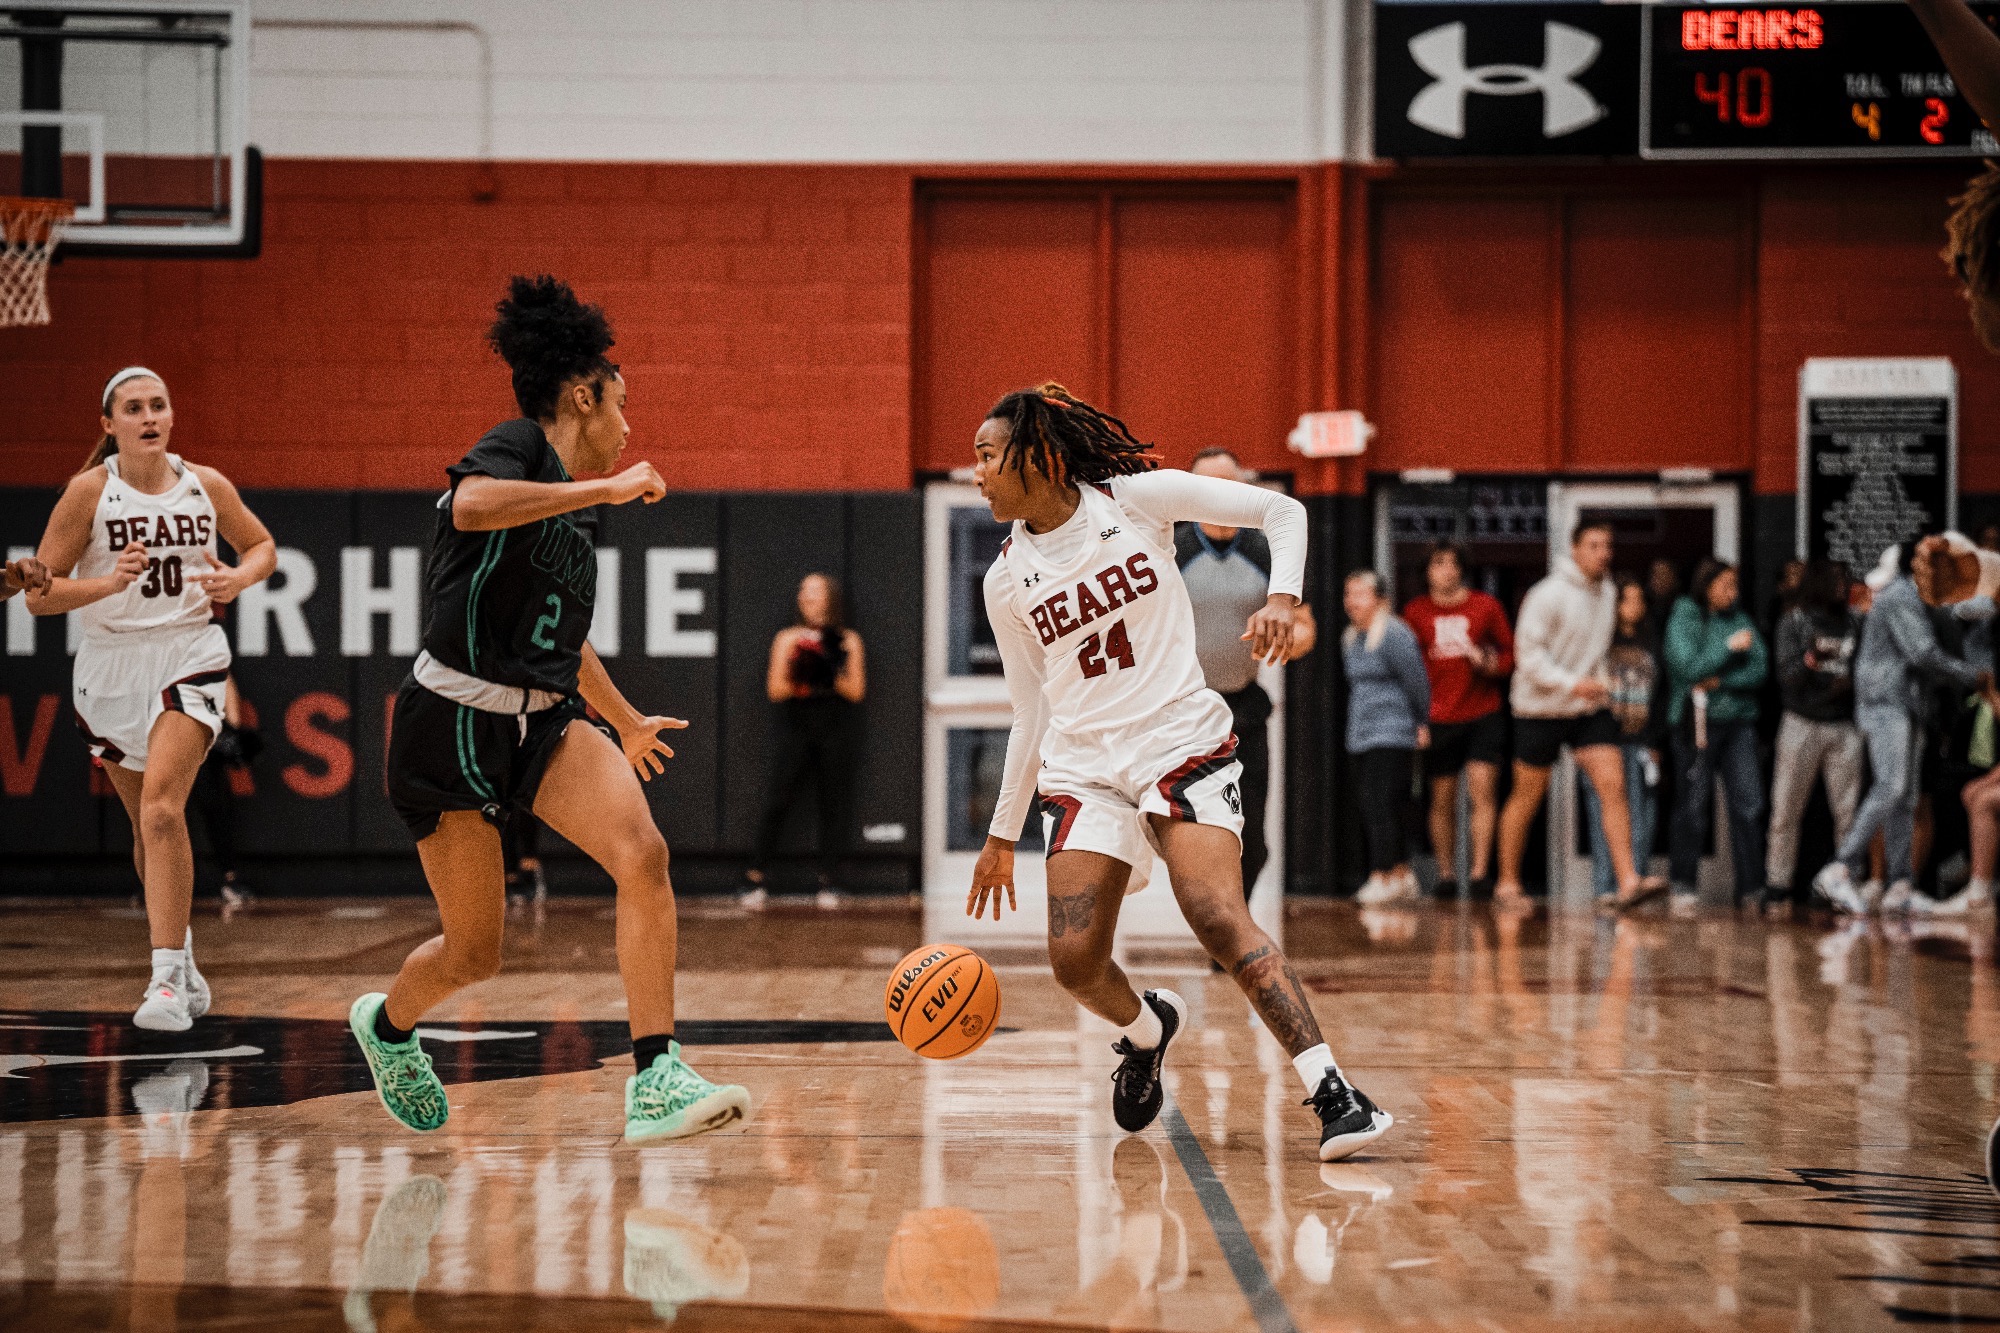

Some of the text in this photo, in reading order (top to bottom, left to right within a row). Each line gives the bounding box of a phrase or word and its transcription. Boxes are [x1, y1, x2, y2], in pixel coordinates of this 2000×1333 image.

[1682, 9, 1825, 51] BEARS
[1693, 66, 1773, 128] 40
[1919, 97, 1950, 144] 2
[1851, 101, 1882, 142] 4
[105, 514, 212, 552] BEARS
[1100, 526, 1121, 541] SAC
[141, 555, 183, 598] 30
[1029, 552, 1159, 647] BEARS
[531, 594, 561, 650] 2
[1077, 618, 1136, 680] 24
[888, 950, 950, 1013] Wilson
[922, 976, 959, 1023] EVO
